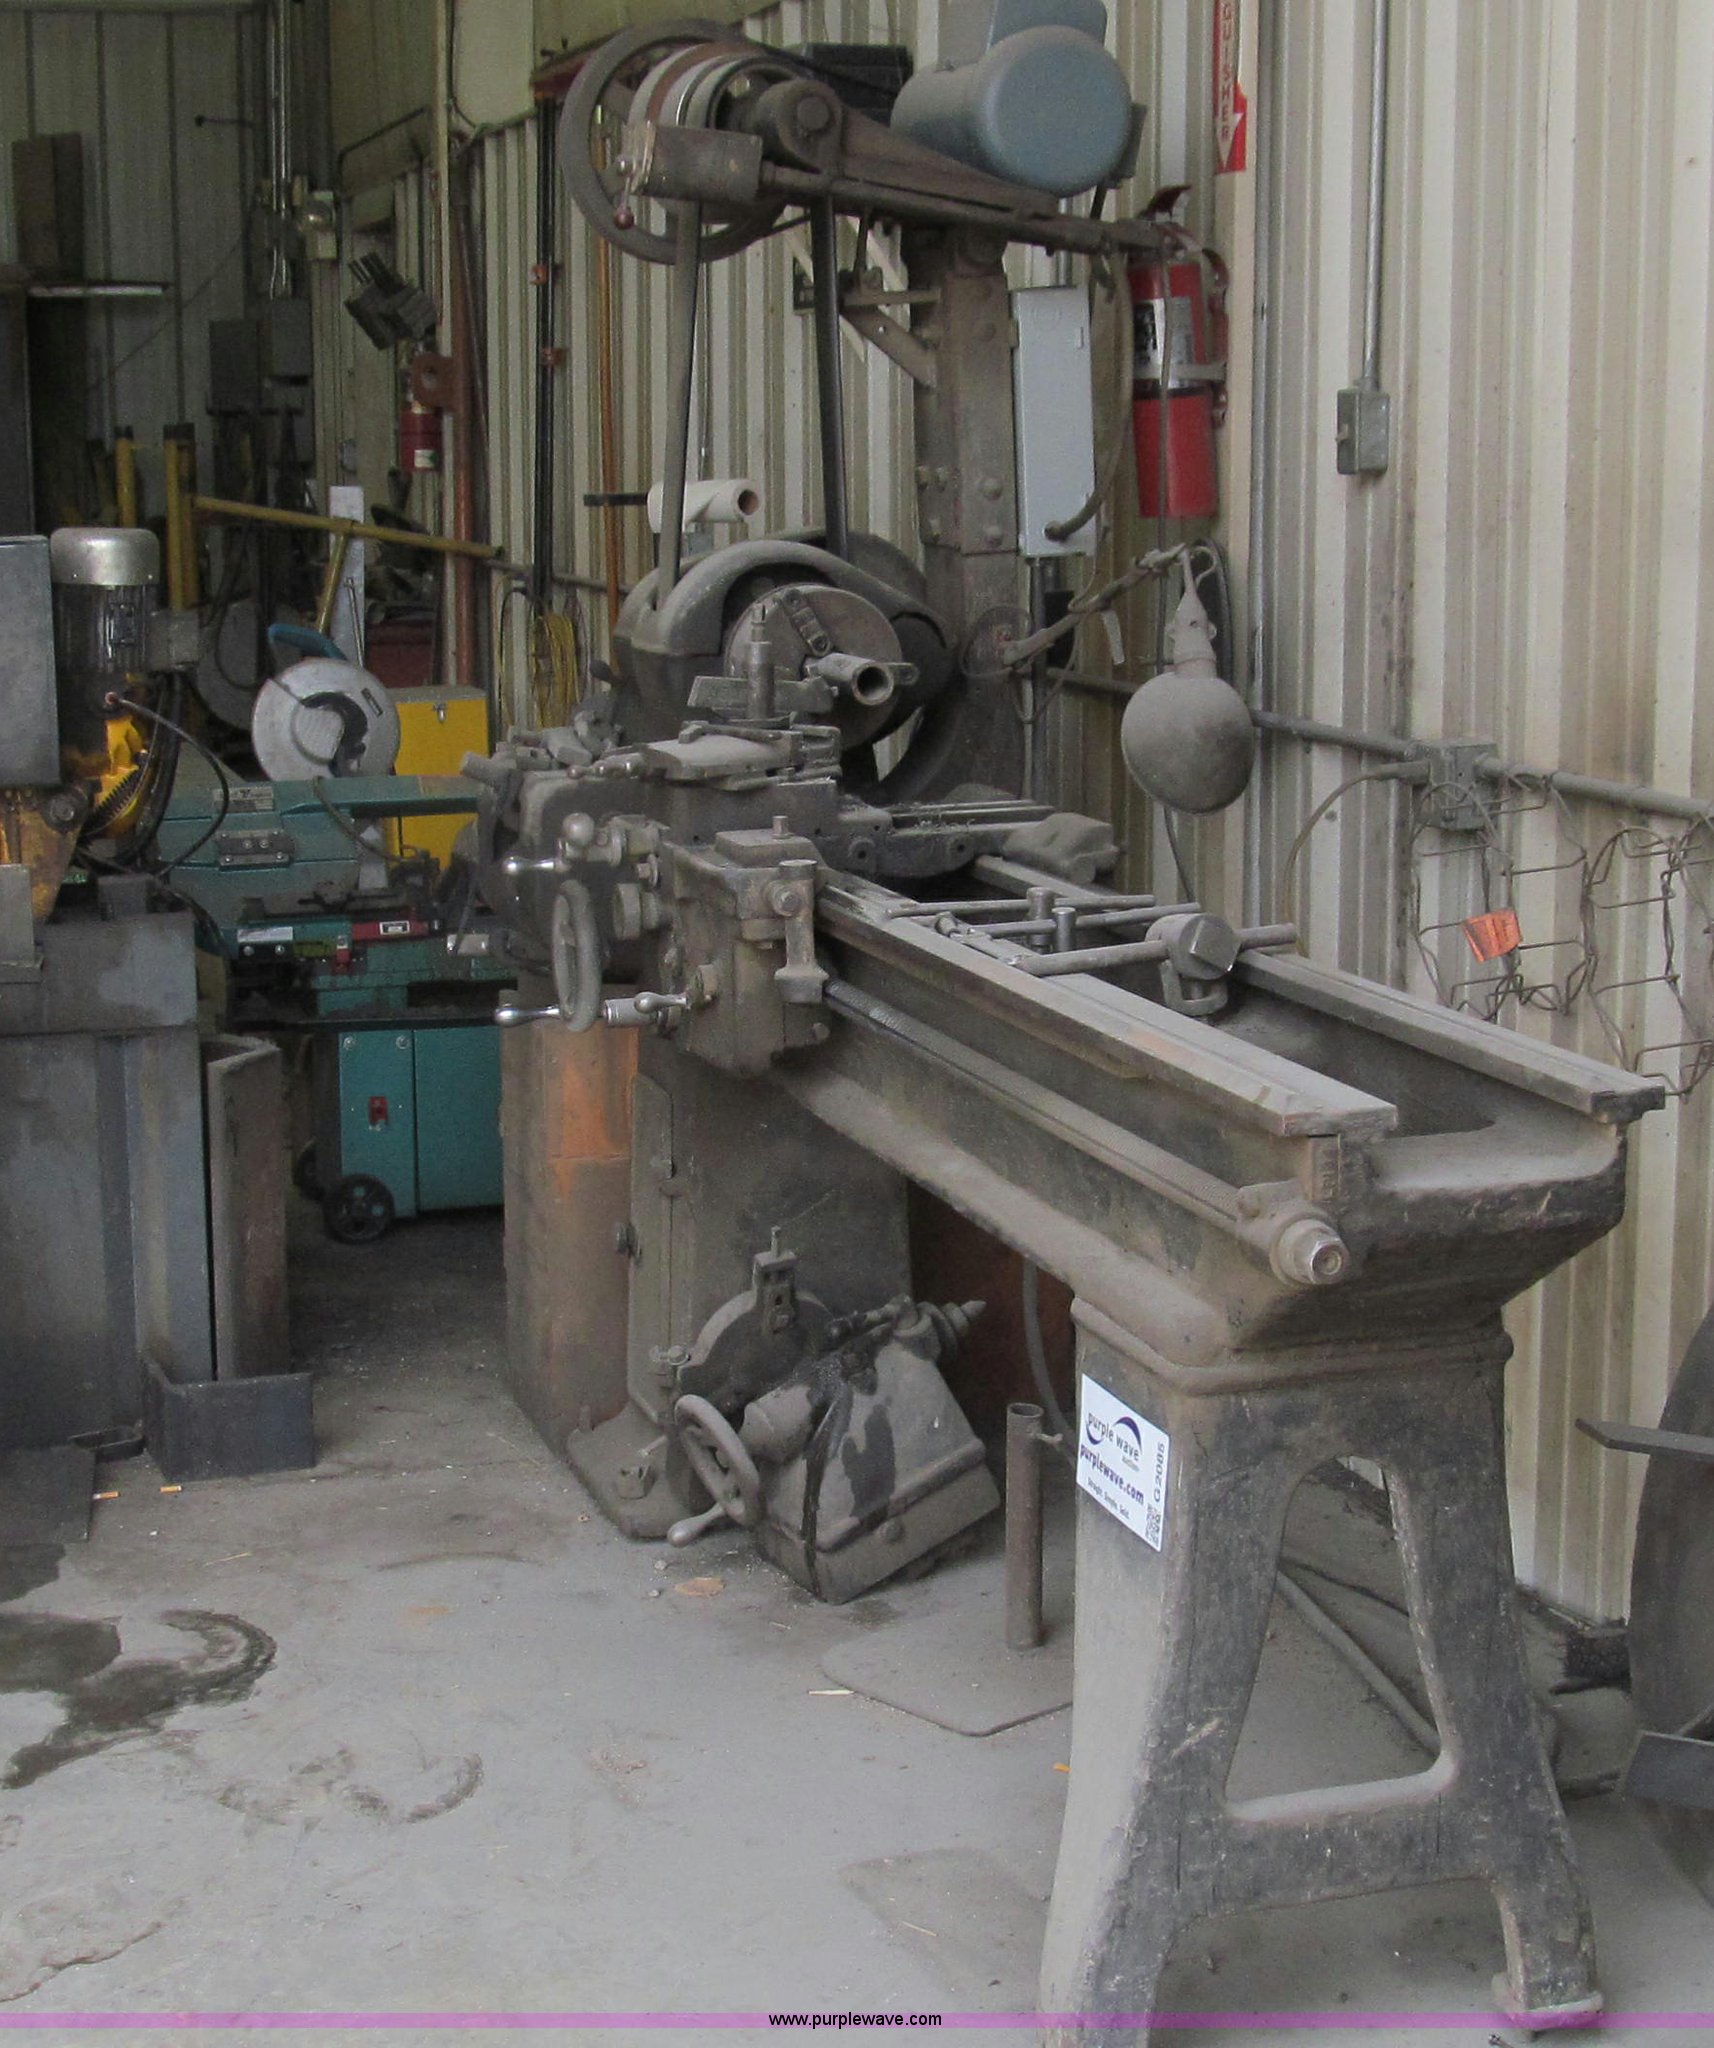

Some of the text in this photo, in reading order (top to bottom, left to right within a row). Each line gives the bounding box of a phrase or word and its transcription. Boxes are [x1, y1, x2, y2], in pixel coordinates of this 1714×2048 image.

[1088, 1412, 1139, 1461] purple wave
[1080, 1444, 1144, 1505] purplewave.com
